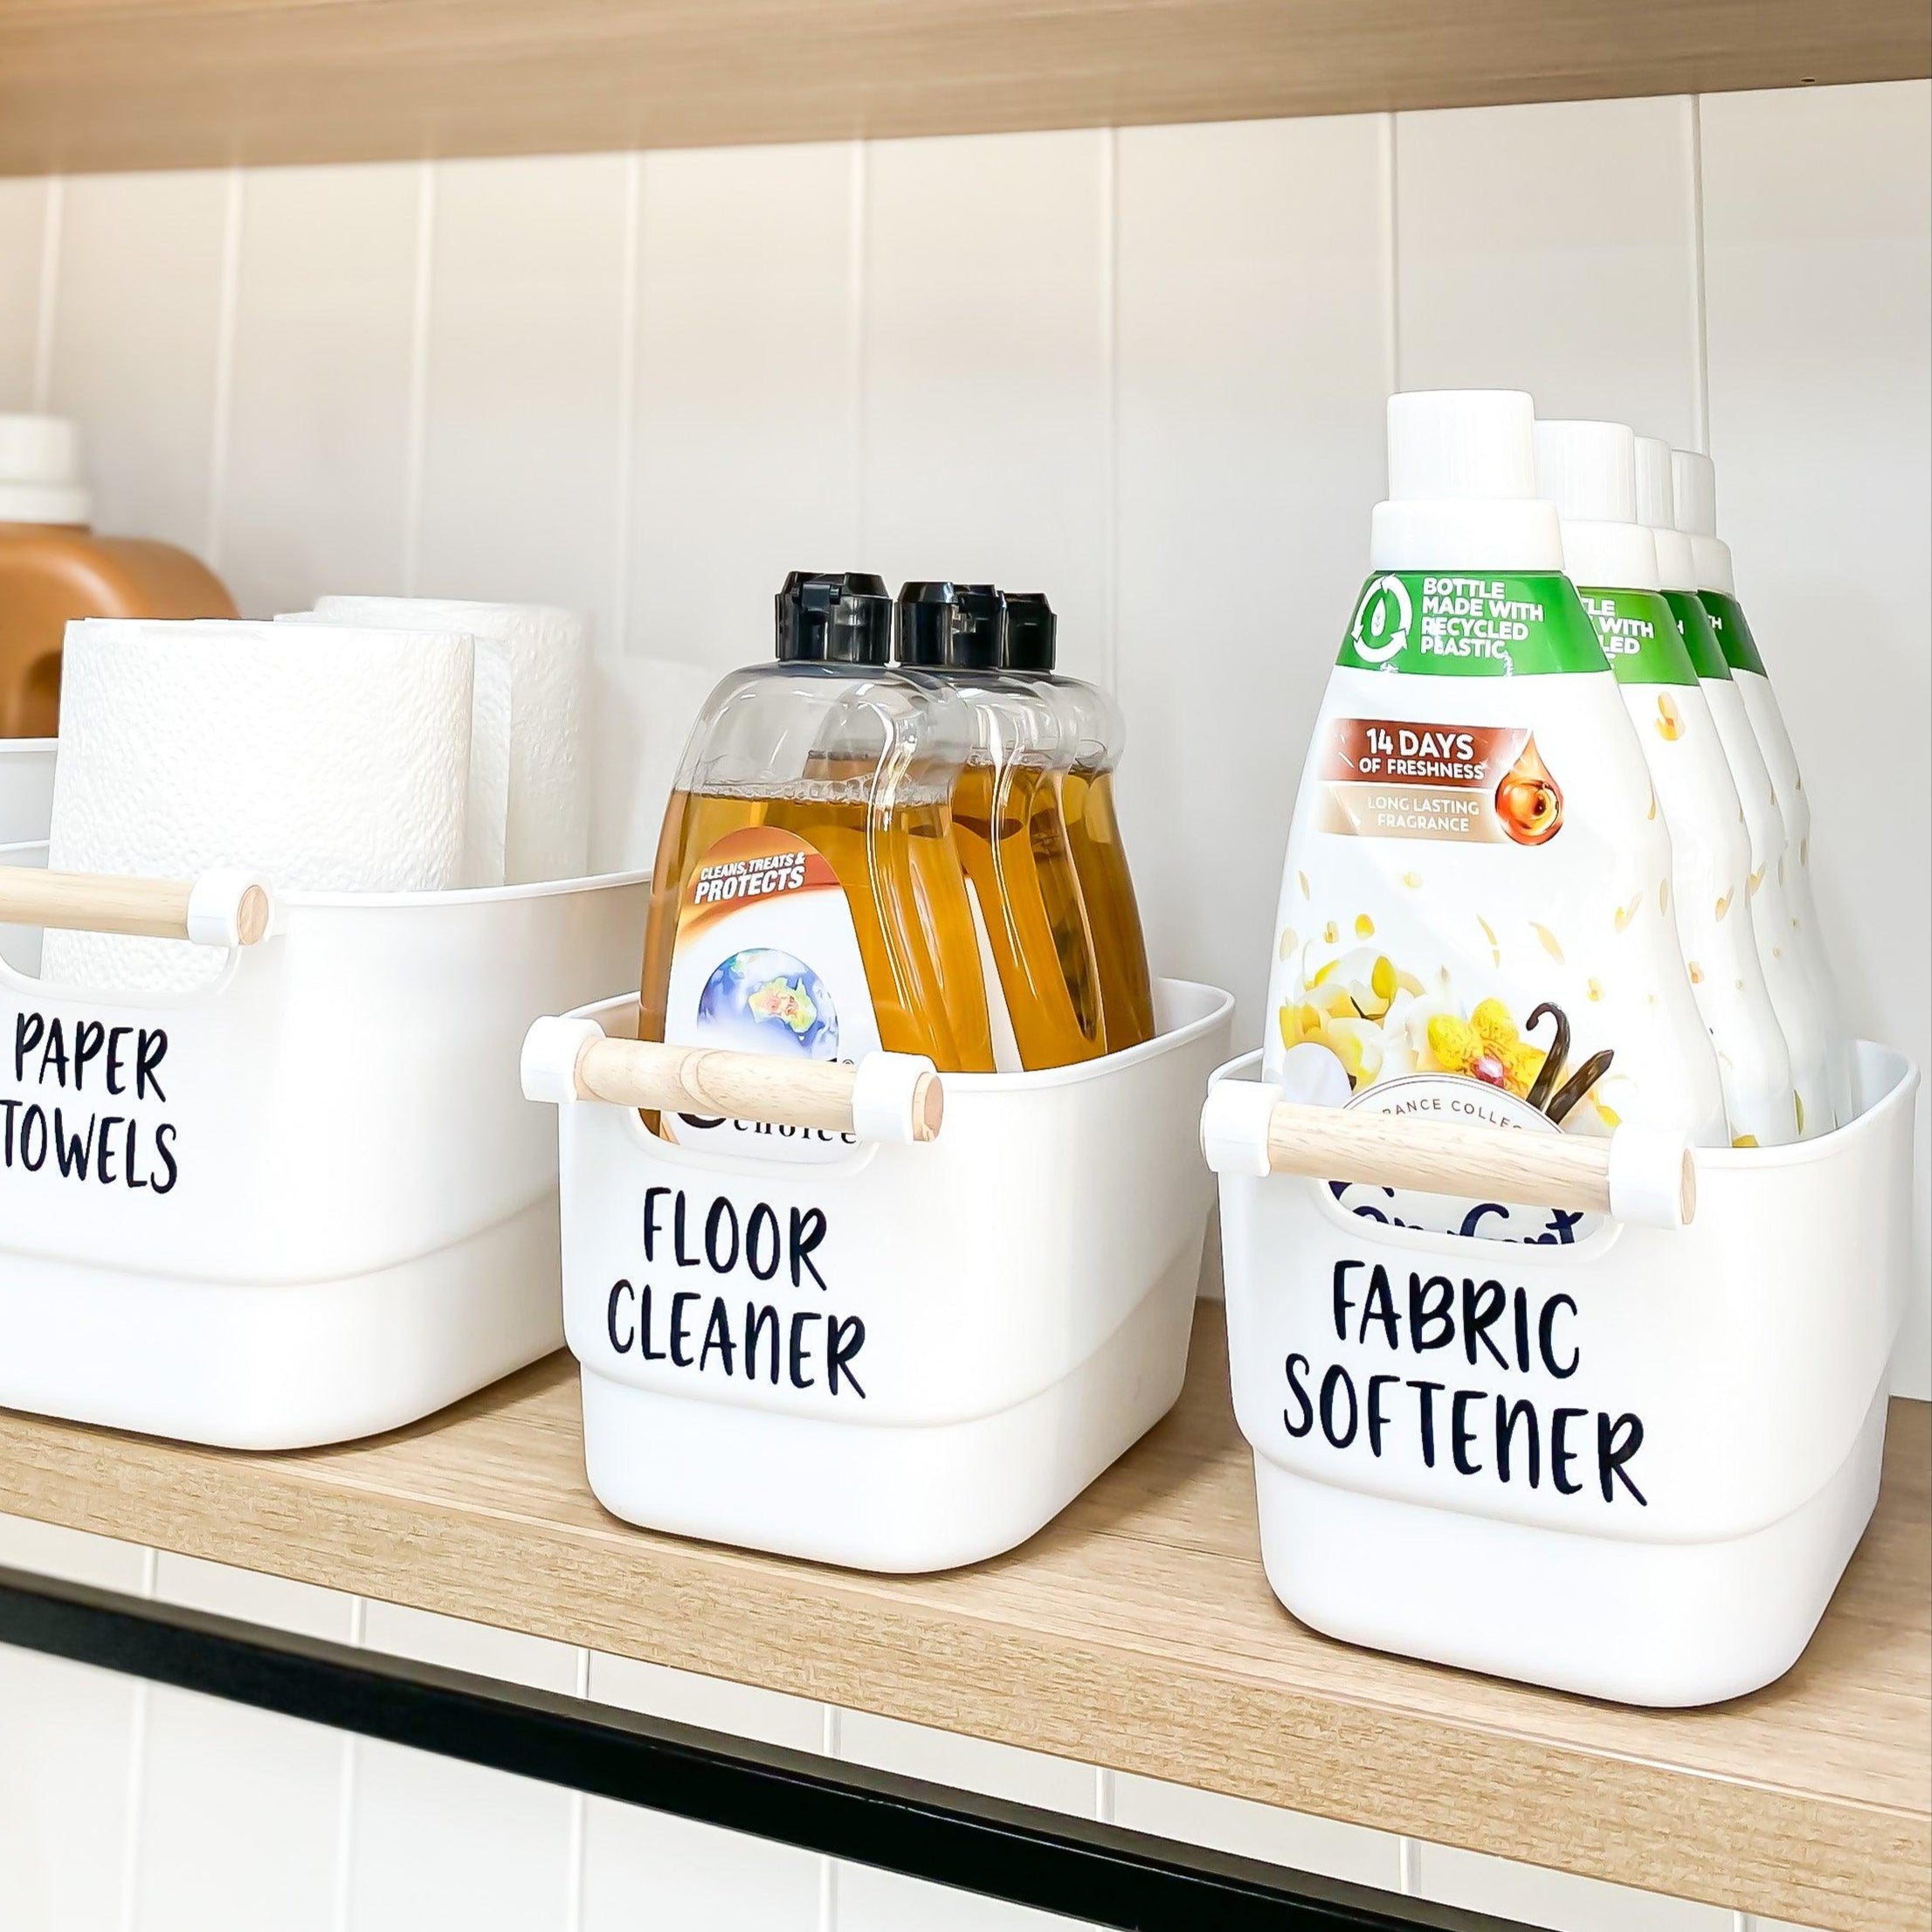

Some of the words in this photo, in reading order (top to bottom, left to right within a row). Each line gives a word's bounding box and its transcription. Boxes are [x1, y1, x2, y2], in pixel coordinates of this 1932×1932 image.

[1423, 576, 1505, 600] BOTTLE
[1423, 596, 1484, 617] MADE
[1488, 600, 1544, 622] WITH
[1422, 617, 1529, 641] RECYCLED
[1599, 616, 1654, 638] WITH
[1420, 636, 1507, 659] PLASTIC
[1366, 728, 1394, 756] 14
[1398, 729, 1474, 761] DAYS
[1359, 757, 1382, 774] OF
[1387, 758, 1485, 781] FRESHNESS
[1369, 796, 1410, 811] LONG
[1413, 797, 1480, 816] LASTING
[1377, 814, 1470, 832] FRAGRANCE
[700, 862, 748, 881] CLEANS,
[749, 853, 795, 873] TREATS
[795, 852, 805, 866] &
[693, 866, 805, 905] PROTECTS
[15, 1011, 168, 1103] PAPER
[1451, 1101, 1522, 1129] COLLE
[0, 1099, 177, 1195] TOWELS
[644, 1186, 827, 1292] FLOOR
[1333, 1259, 1580, 1379] FABRIC
